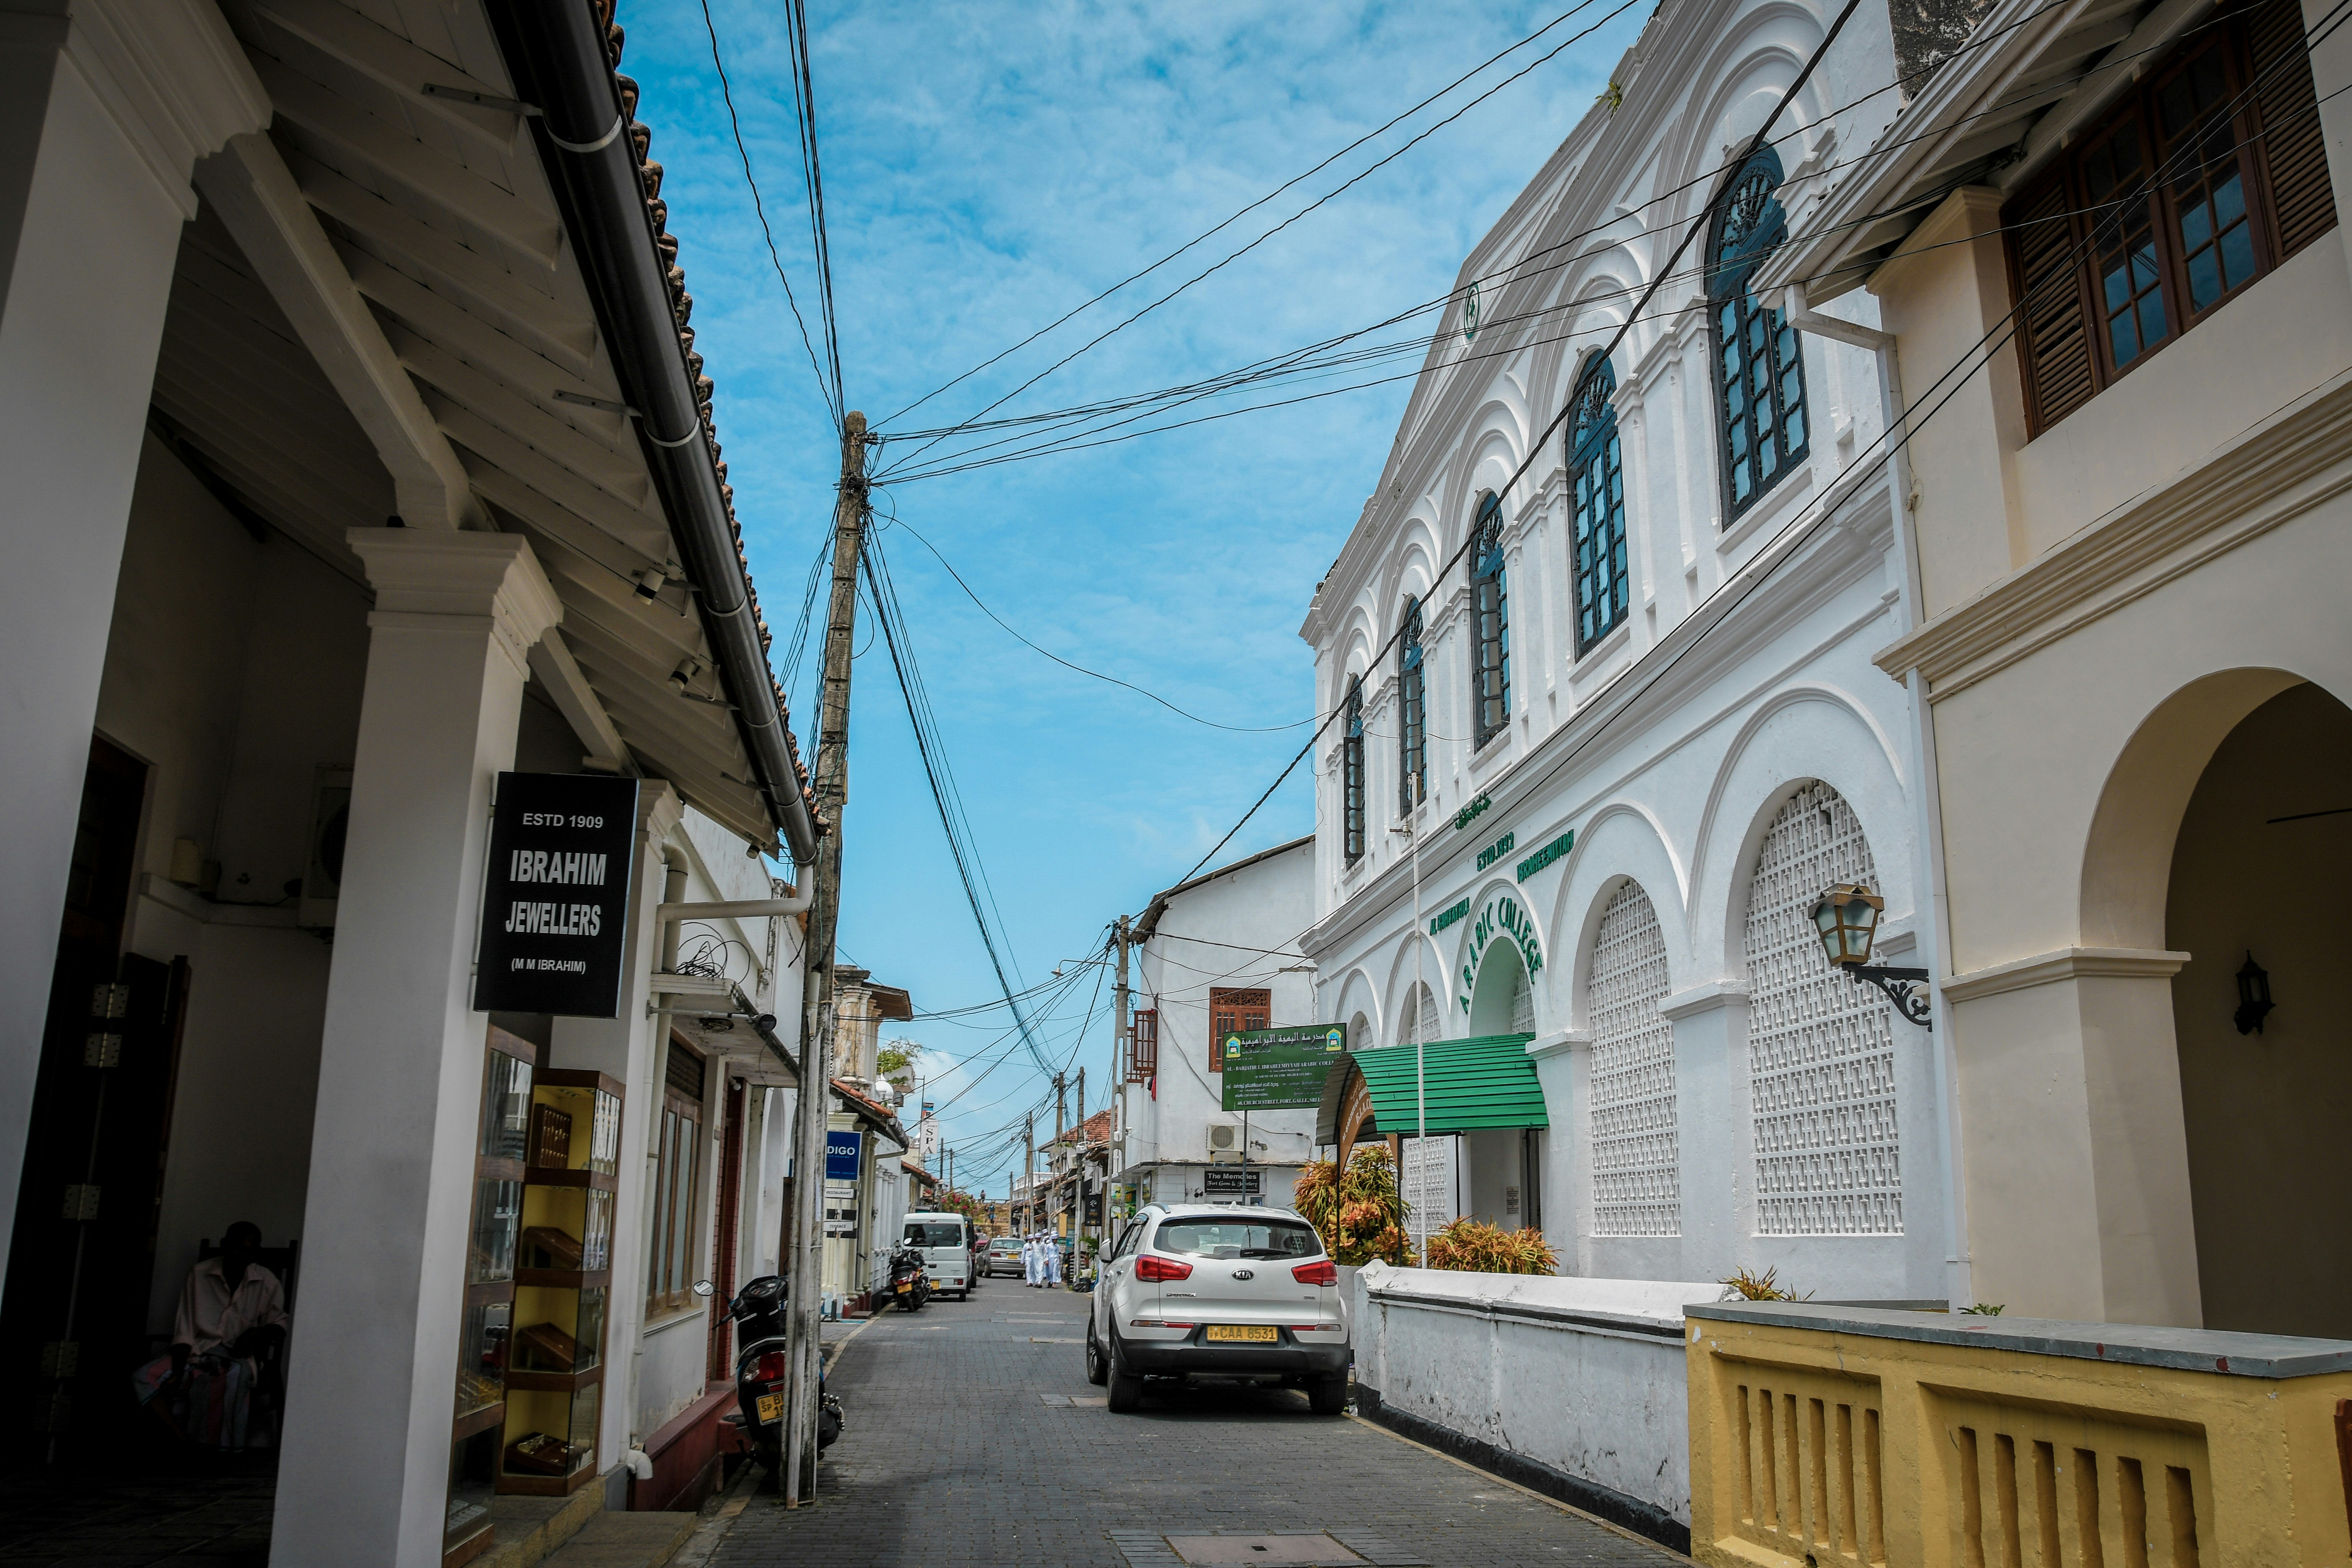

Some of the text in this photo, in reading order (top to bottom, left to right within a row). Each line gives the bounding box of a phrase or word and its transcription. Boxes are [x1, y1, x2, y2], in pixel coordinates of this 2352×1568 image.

[523, 813, 604, 828] ESTD 1909
[509, 850, 607, 885] IBRAHIM
[505, 901, 601, 936] JEWELLERS
[1459, 897, 1543, 1015] ARABIC COLLEGE
[511, 958, 586, 975] (M M IBRAHIM)
[827, 1146, 855, 1155] DIGO
[1236, 1271, 1251, 1279] KIA
[1220, 1327, 1242, 1339] CAA
[1247, 1327, 1275, 1339] 8531
[762, 1404, 771, 1412] SP
